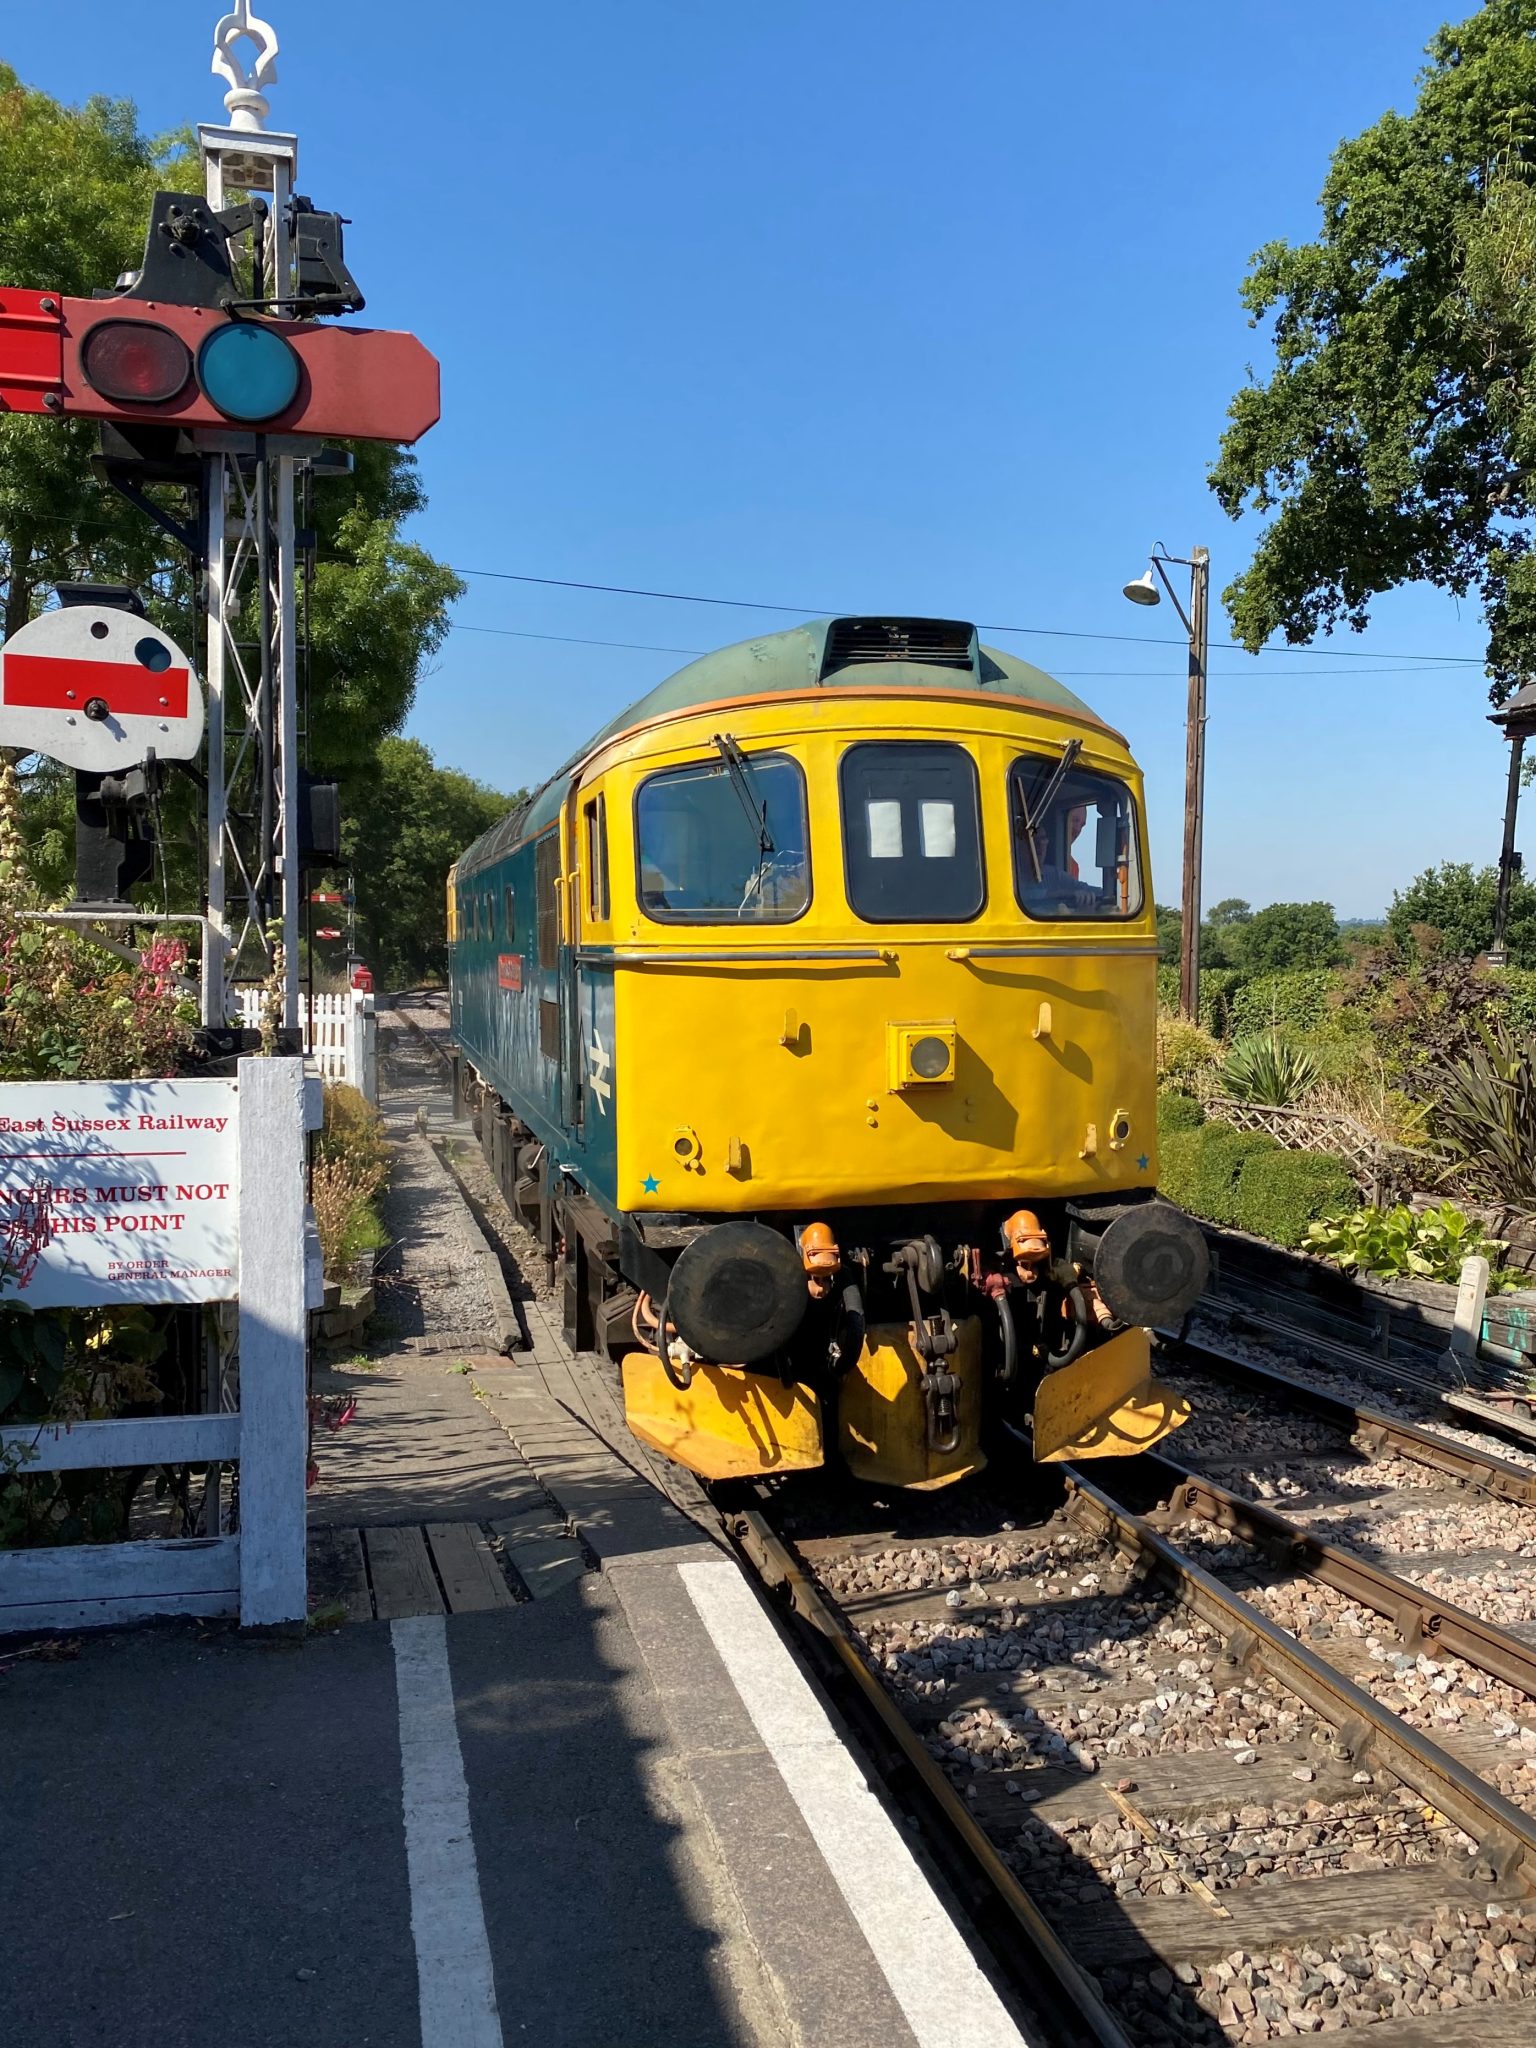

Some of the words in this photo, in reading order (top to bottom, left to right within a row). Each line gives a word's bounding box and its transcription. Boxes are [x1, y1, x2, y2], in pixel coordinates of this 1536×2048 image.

[0, 1117, 45, 1133] East
[52, 1116, 131, 1132] Sussex
[138, 1115, 229, 1133] Railway
[94, 1186, 168, 1203] MUST
[175, 1184, 230, 1201] NOT
[104, 1214, 185, 1232] POINT
[108, 1261, 124, 1270] BY
[126, 1260, 169, 1269] ORDER
[108, 1271, 168, 1281] GENERAL
[170, 1268, 232, 1278] MANAGER
